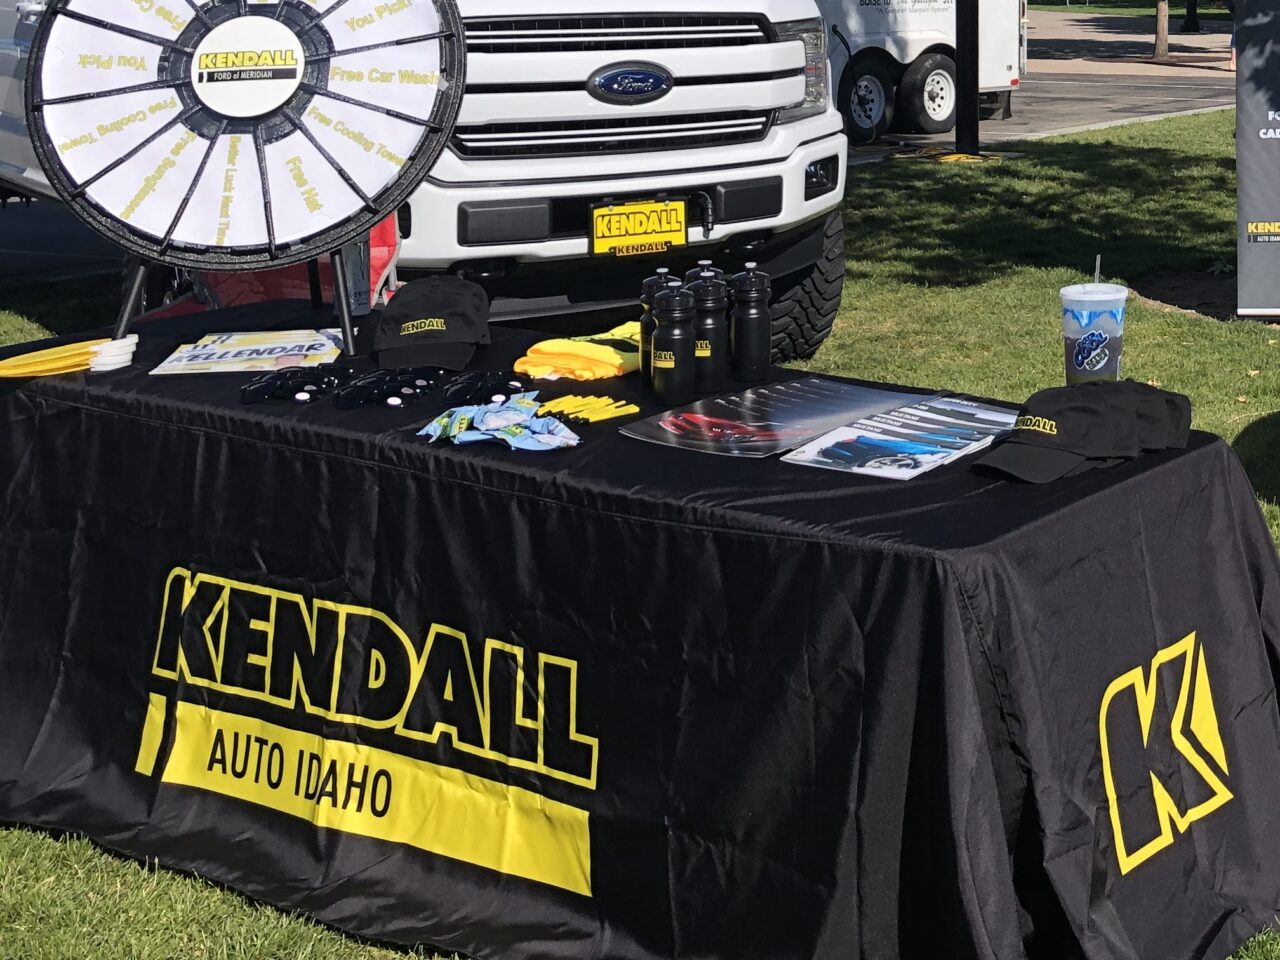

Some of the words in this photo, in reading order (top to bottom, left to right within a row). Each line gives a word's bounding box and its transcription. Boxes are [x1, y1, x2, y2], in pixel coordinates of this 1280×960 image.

[155, 6, 188, 32] Free
[344, 13, 375, 32] You
[78, 54, 113, 70] Pick
[117, 55, 148, 71] You
[199, 49, 298, 70] KENDALL
[214, 71, 231, 80] FORD
[233, 71, 240, 80] of
[240, 70, 273, 79] MERIDIAN
[330, 66, 364, 82] Free
[367, 67, 395, 83] Car
[398, 69, 440, 85] Wash
[148, 96, 177, 114] Free
[307, 106, 332, 127] Free
[223, 169, 237, 193] Luck
[285, 155, 308, 188] Free
[595, 209, 682, 239] KENDALL
[616, 243, 667, 256] KENDALL
[168, 343, 327, 364] KELLENDAR
[151, 566, 599, 790] KENDALL
[1099, 630, 1234, 876] K
[207, 728, 285, 790] AUTO
[294, 752, 392, 818] IDAHO
